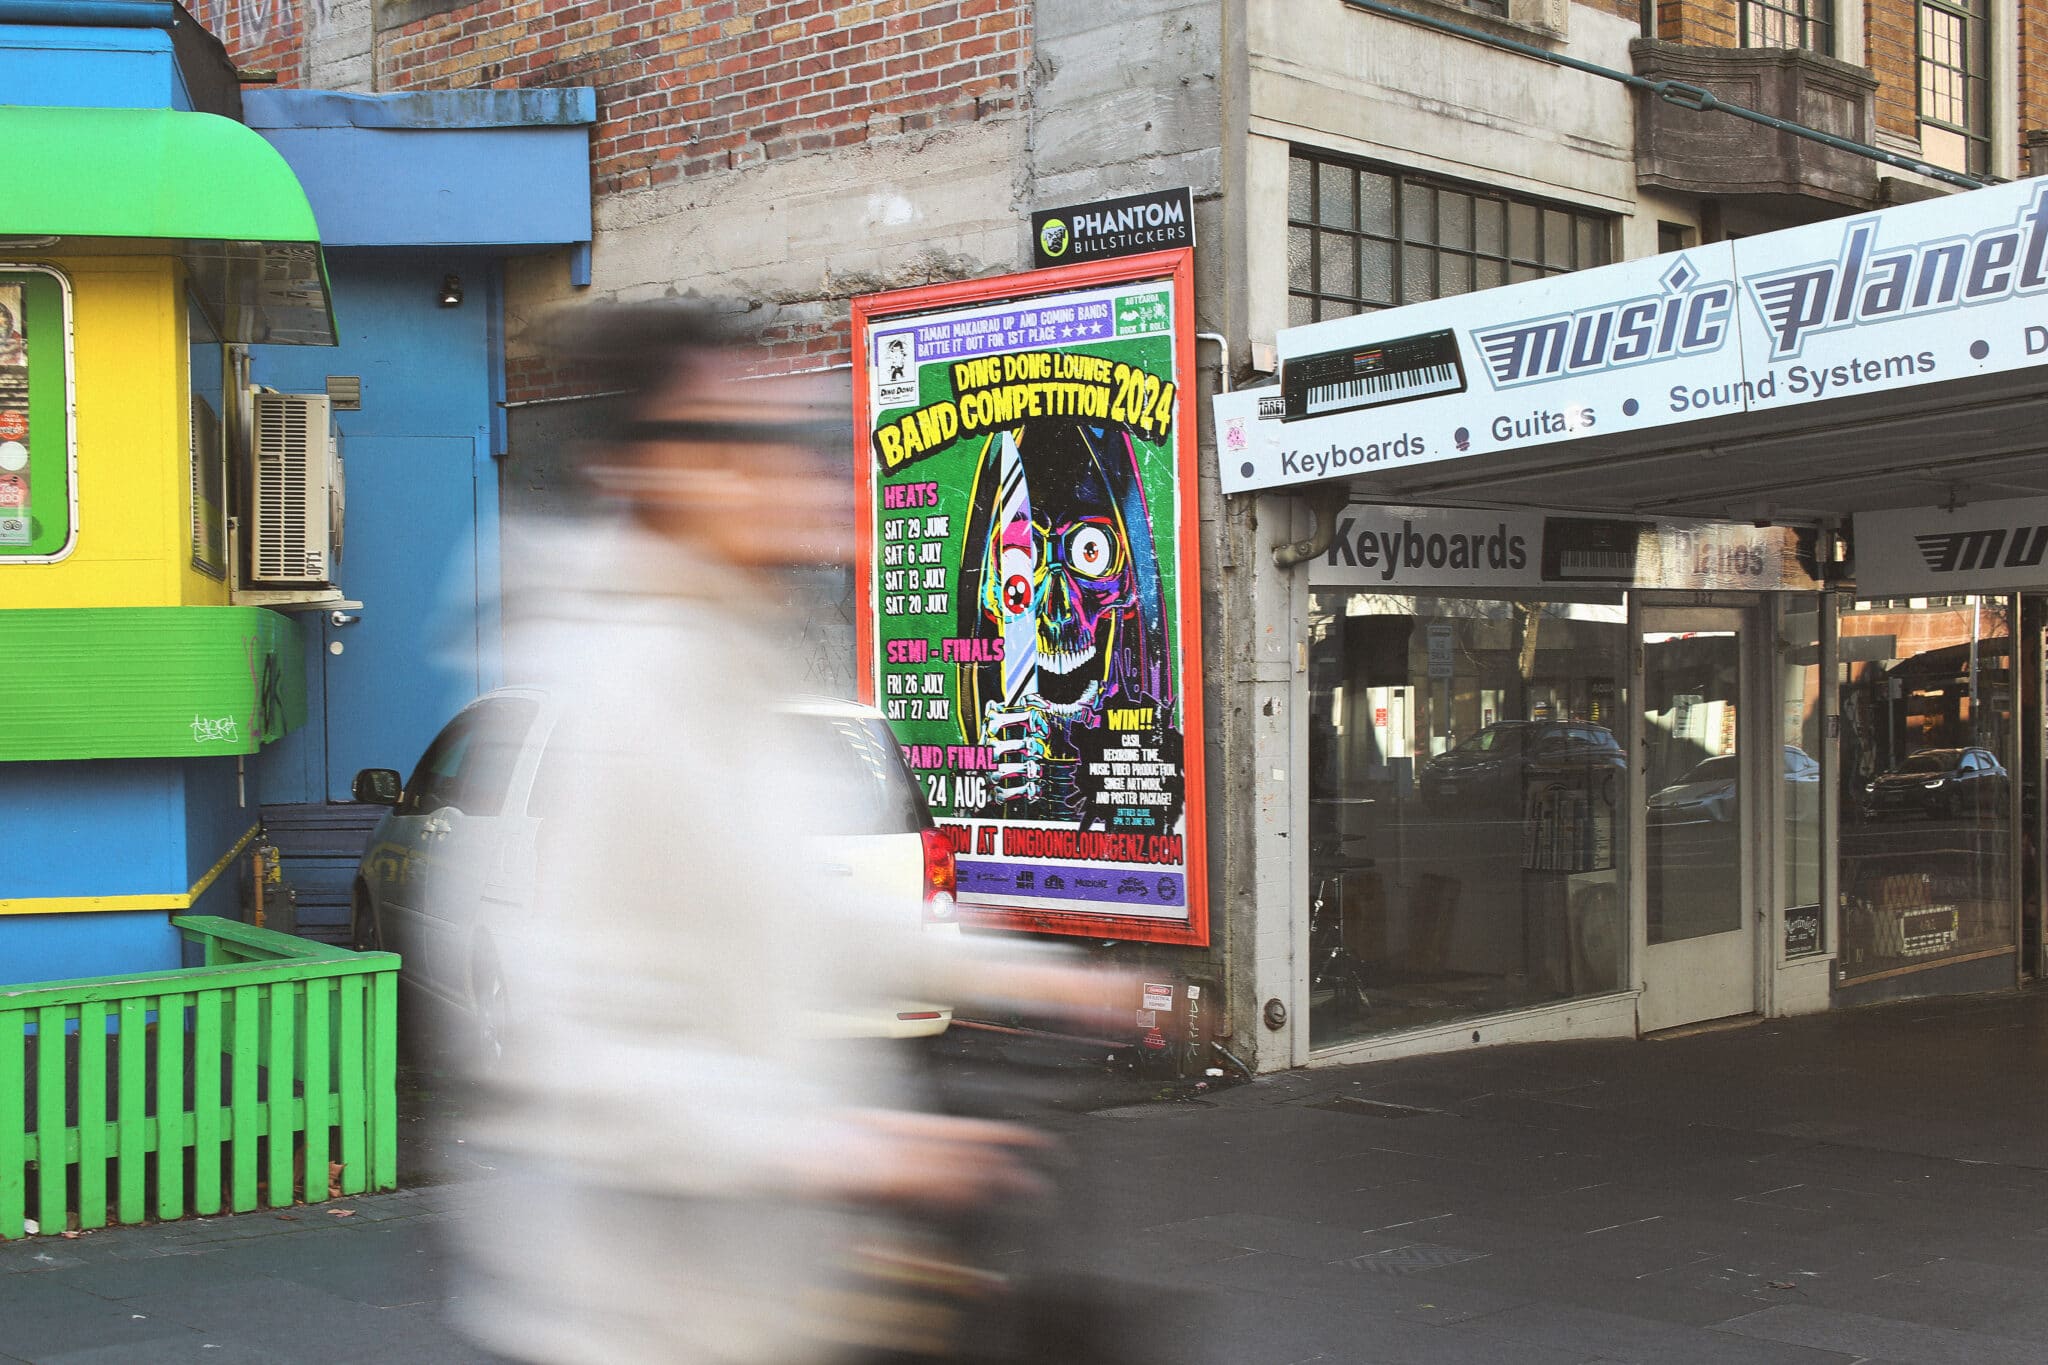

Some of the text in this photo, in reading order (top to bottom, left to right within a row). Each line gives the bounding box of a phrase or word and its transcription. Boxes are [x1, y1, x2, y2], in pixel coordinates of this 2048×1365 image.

[1073, 199, 1185, 239] PHANTOM
[1075, 225, 1186, 254] BILLSTICKERS
[953, 318, 1000, 337] MAKAURAU
[1003, 316, 1015, 331] UP
[1020, 313, 1038, 328] AND
[1040, 308, 1075, 325] COMING
[1078, 303, 1108, 321] BANDS
[918, 340, 950, 357] BATTLE
[952, 338, 963, 353] IT
[965, 335, 985, 351] OUT
[987, 333, 1005, 348] FOR
[1028, 325, 1057, 343] PLACE
[955, 352, 1114, 391] DING DONG LOUNGE
[1669, 370, 1776, 413] Sound
[1787, 350, 1936, 397] Systems
[877, 401, 958, 468] BAND
[959, 382, 1111, 430] COMPETITION
[1111, 363, 1175, 436] 2024
[1281, 433, 1425, 477] Keyboards
[1491, 405, 1597, 443] Guitas
[884, 482, 938, 508] HEATS
[884, 516, 950, 541] SAT 29 JUNE
[884, 542, 943, 566] SAT 6 JULY
[1328, 517, 1528, 581] Keyboards
[885, 568, 946, 591] SAT 13 JULY
[885, 593, 948, 615] SAT 20 JULY
[886, 640, 928, 663] SEMI
[942, 638, 1005, 662] FINALS
[887, 673, 944, 695] FRI 26 JULY
[888, 699, 950, 720] SAT 27 JULY
[1107, 708, 1154, 730] WIN!!
[946, 745, 998, 770] FINAL
[1089, 763, 1110, 776] MUSIC
[1111, 763, 1131, 776] VIDEO
[927, 774, 987, 808] 24 AUG
[1096, 791, 1110, 805] AND
[1110, 791, 1138, 805] POSTER
[976, 825, 999, 855] AT
[1002, 825, 1183, 866] DINGDONGLOUNGENZ.COM
